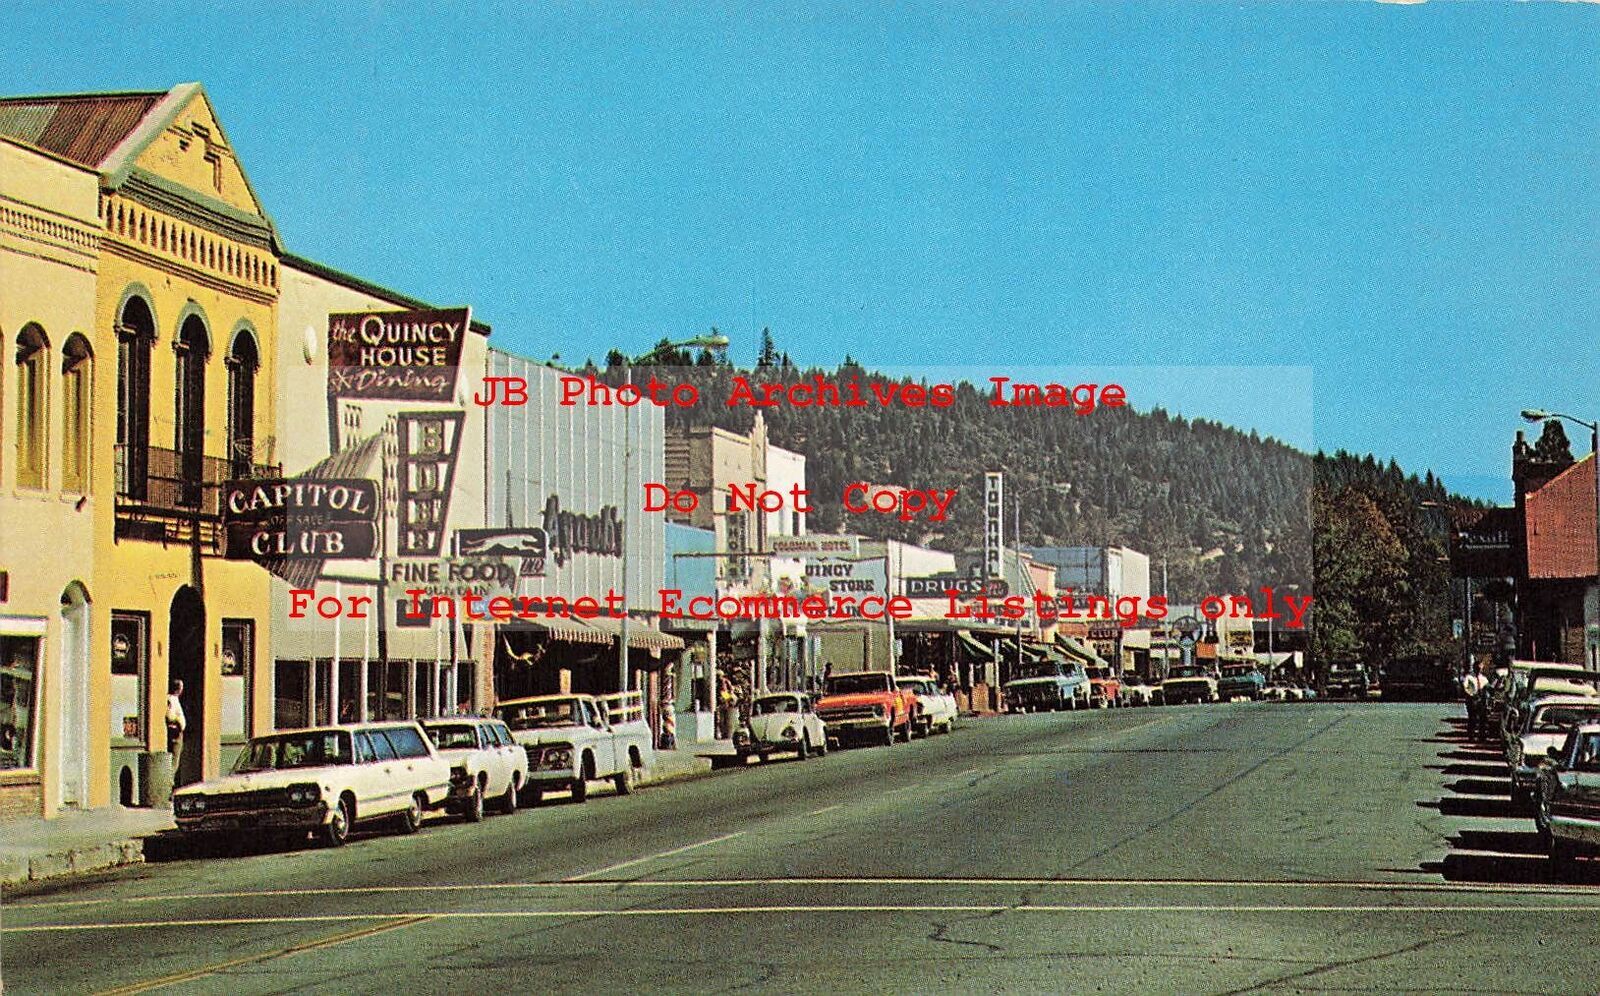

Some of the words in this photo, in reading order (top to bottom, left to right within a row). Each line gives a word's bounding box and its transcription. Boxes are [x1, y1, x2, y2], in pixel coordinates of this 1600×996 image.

[332, 319, 356, 343] the
[360, 314, 460, 346] QUINCY
[360, 345, 447, 367] HOUSE
[355, 368, 450, 394] Dining
[228, 482, 370, 515] CAPITOL
[251, 530, 345, 556] CLUB
[392, 562, 439, 583] FINE
[448, 562, 514, 583] FOOD
[804, 563, 854, 578] UINCY
[828, 579, 875, 593] STORE
[910, 579, 983, 593] DRUGS
